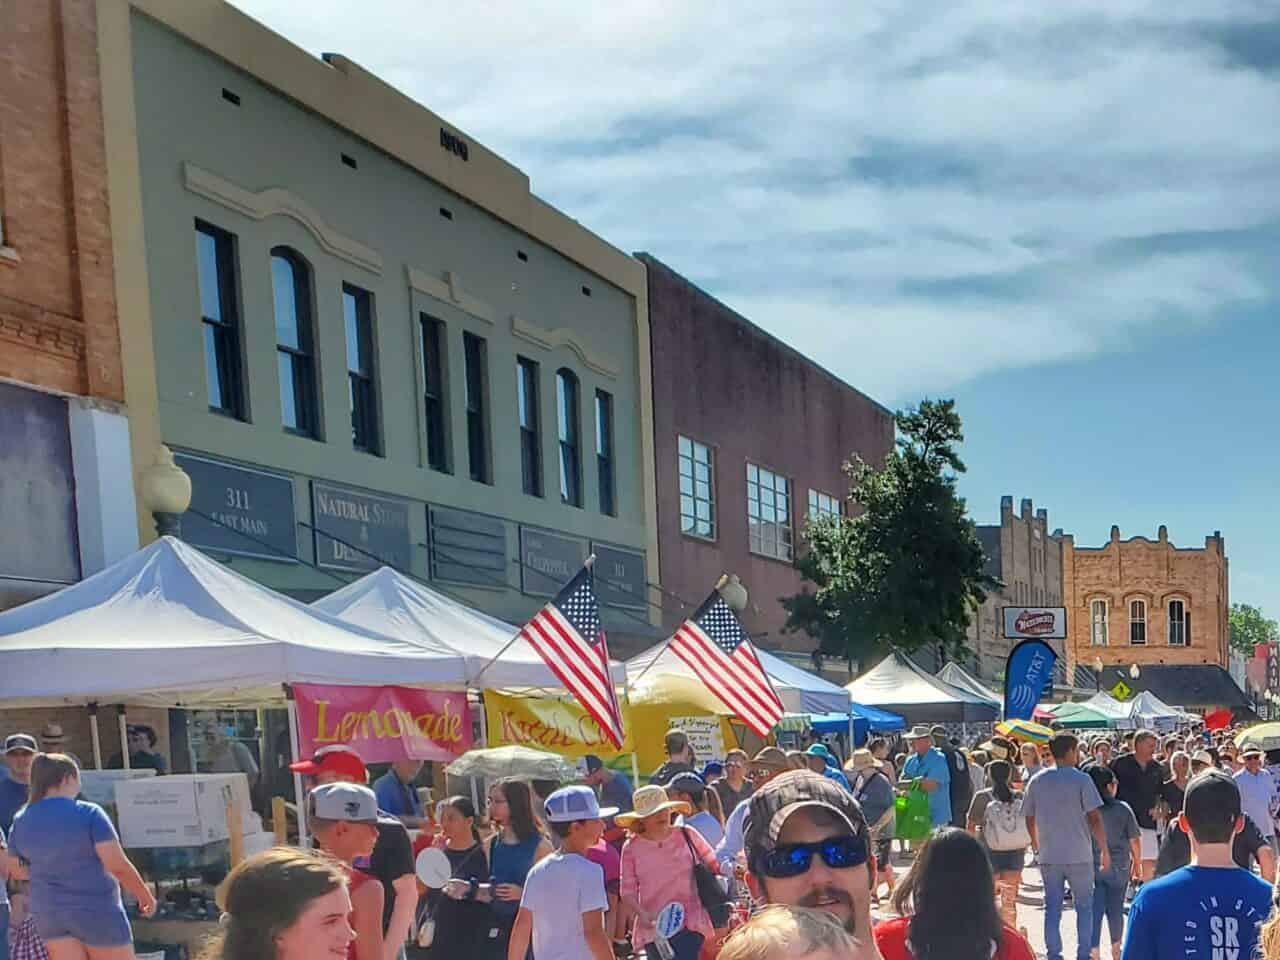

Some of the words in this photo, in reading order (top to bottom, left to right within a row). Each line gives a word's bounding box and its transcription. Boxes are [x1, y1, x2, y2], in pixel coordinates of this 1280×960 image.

[225, 487, 250, 510] 311
[317, 493, 370, 523] NATURAL
[1025, 649, 1047, 684] AT&T
[312, 698, 464, 744] Lemonade
[1210, 915, 1240, 947] SR
